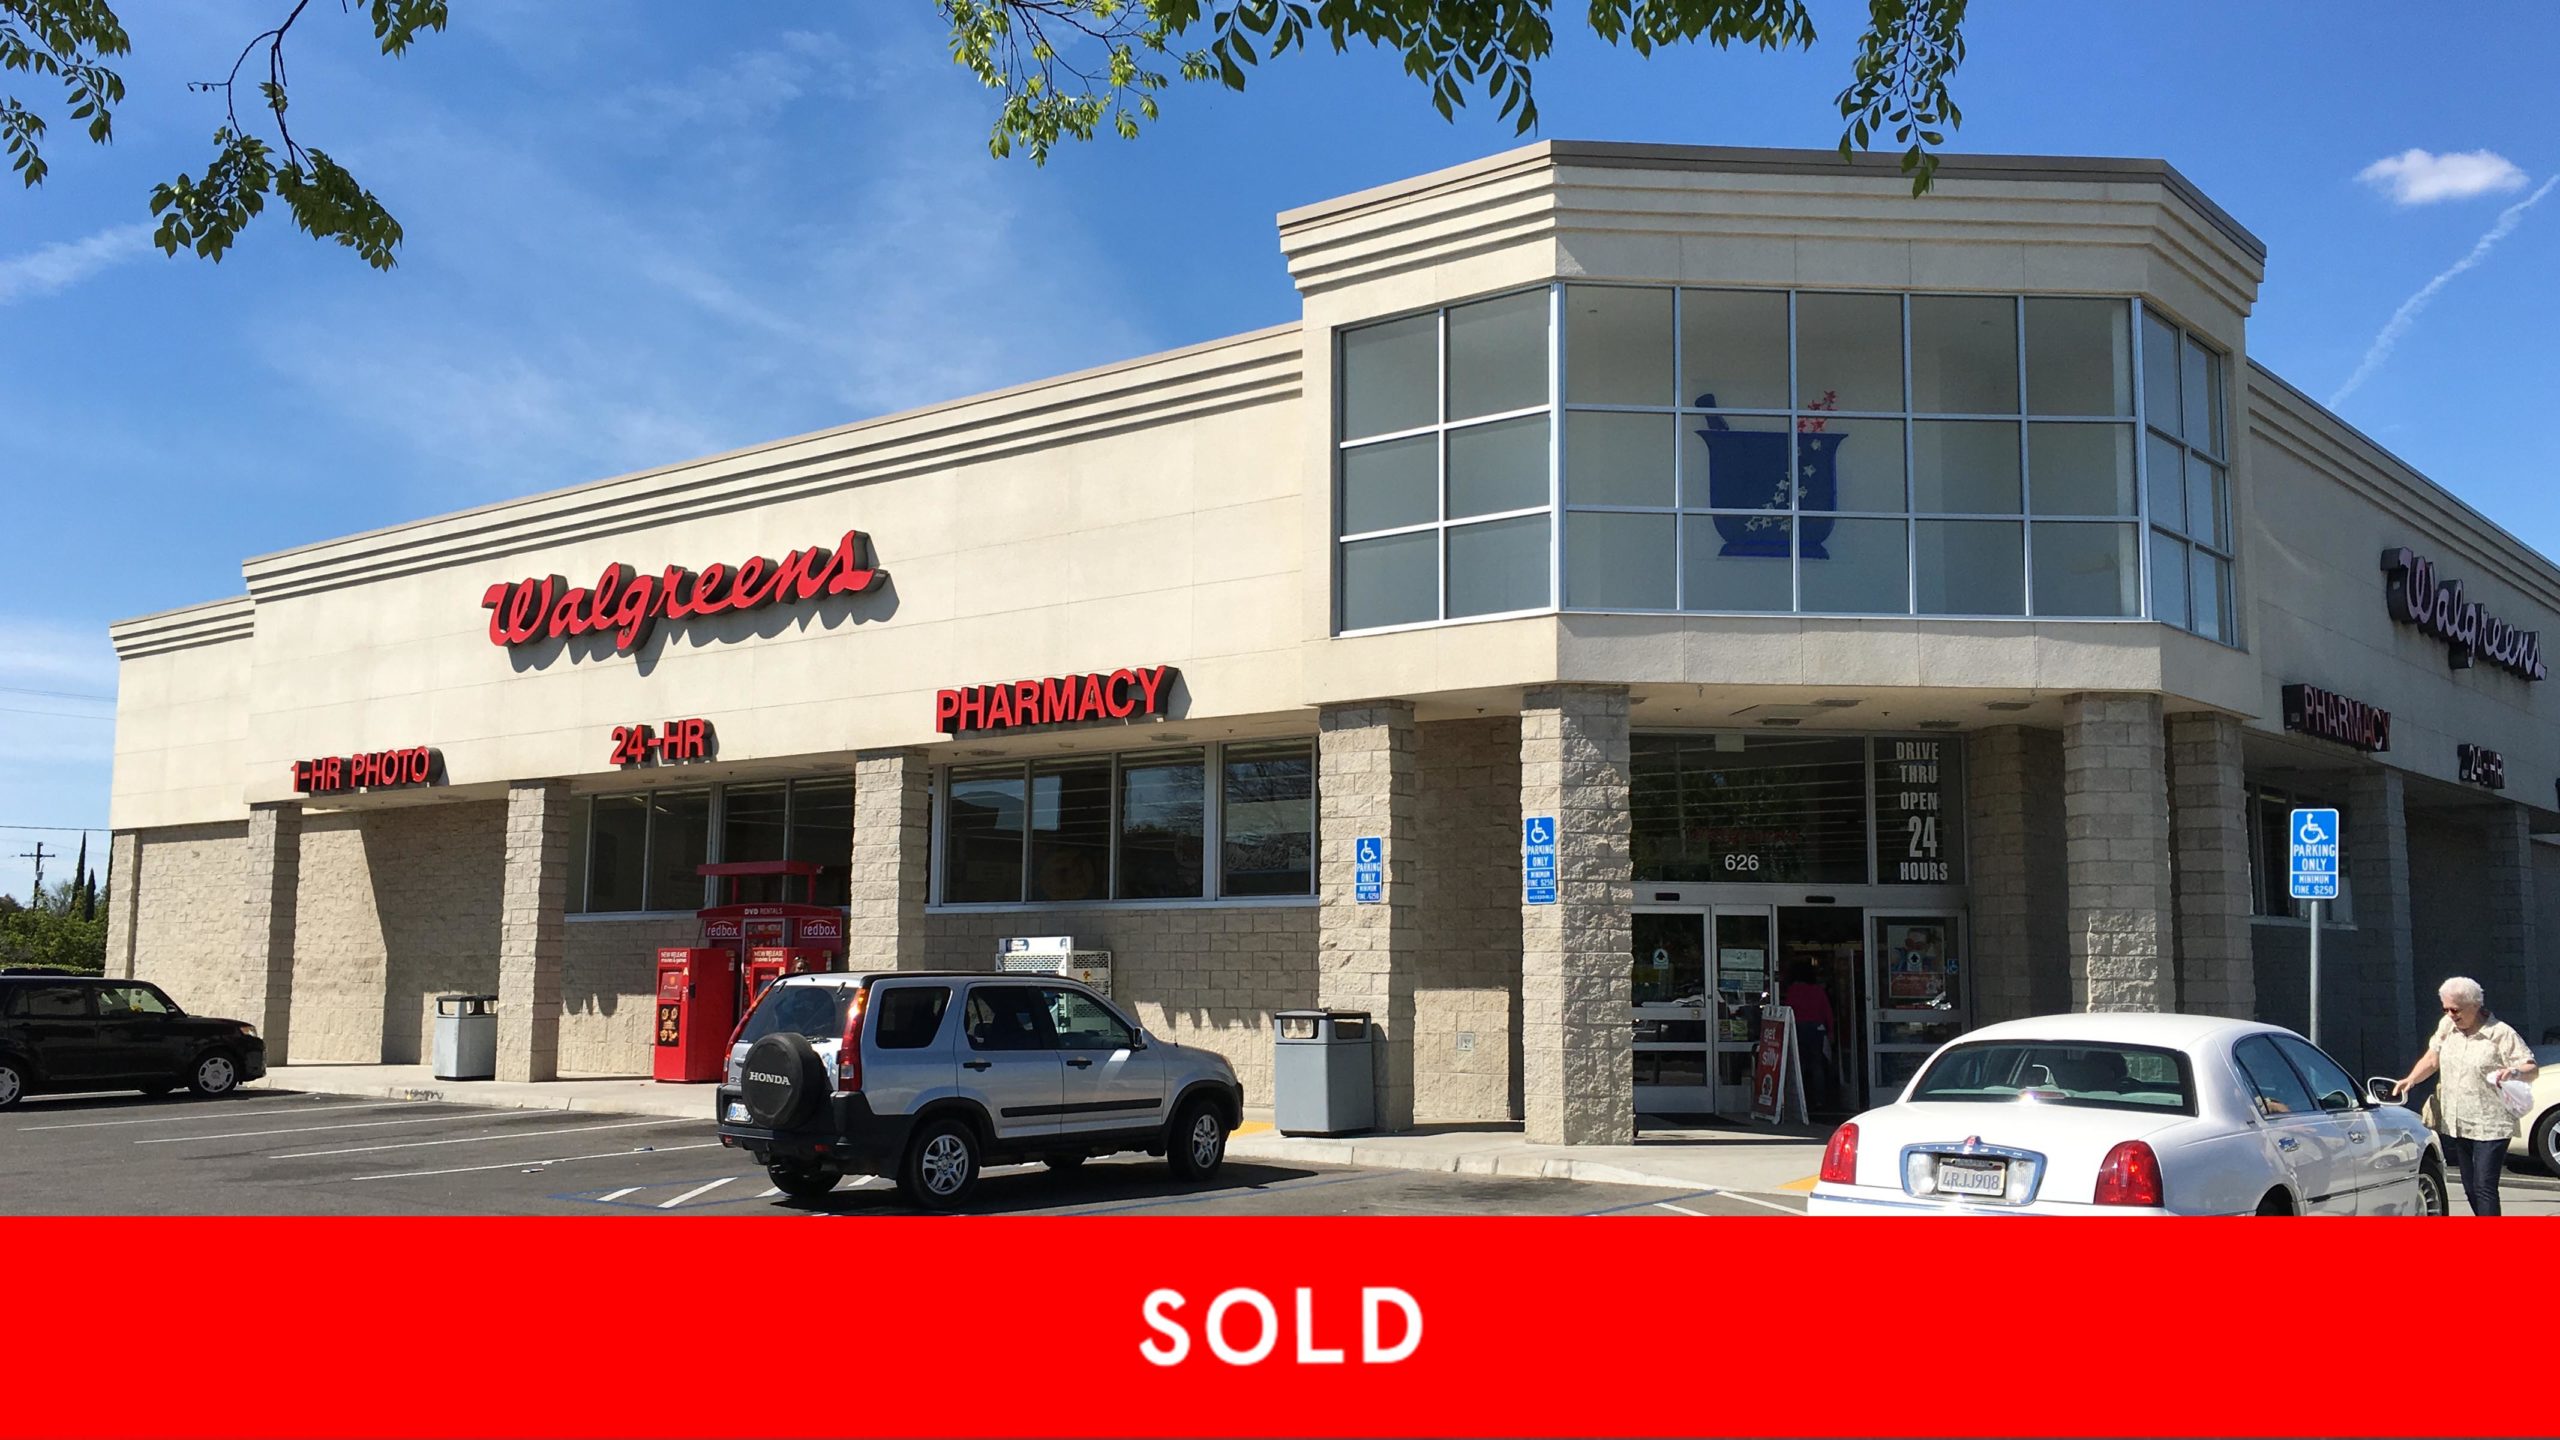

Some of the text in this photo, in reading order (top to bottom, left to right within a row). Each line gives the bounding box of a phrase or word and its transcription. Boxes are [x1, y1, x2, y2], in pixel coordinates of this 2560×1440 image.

[482, 530, 876, 650] Walgreens
[2396, 547, 2548, 682] Walgreens
[937, 665, 1166, 734] PHARMACY
[2301, 684, 2391, 752] PHARMACY
[610, 718, 706, 765] 24-HR
[1896, 741, 1939, 760] DRIVE
[291, 746, 430, 793] 1-HR PHOTO
[1899, 765, 1938, 783] THRU
[2465, 743, 2504, 789] 24-HR
[1900, 791, 1938, 810] OPEN
[1908, 815, 1938, 858] 24
[1527, 844, 1554, 855] PARKING
[2293, 844, 2336, 857] PARKING
[1356, 862, 1381, 873] PARKING
[1532, 856, 1549, 867] ONLY
[1724, 854, 1760, 871] 626
[2301, 858, 2327, 871] ONLY
[1360, 873, 1376, 883] ONLY
[1900, 862, 1949, 880] HOURS
[2298, 874, 2330, 884] MINIMUM
[2294, 885, 2310, 894] FINE
[759, 907, 784, 915] RENTALS
[706, 921, 738, 937] redbox
[803, 921, 837, 936] redbox
[682, 967, 689, 976] A
[1763, 1027, 1777, 1043] get
[749, 1071, 792, 1086] HONDA
[1943, 1170, 2000, 1190] 4RJJ908
